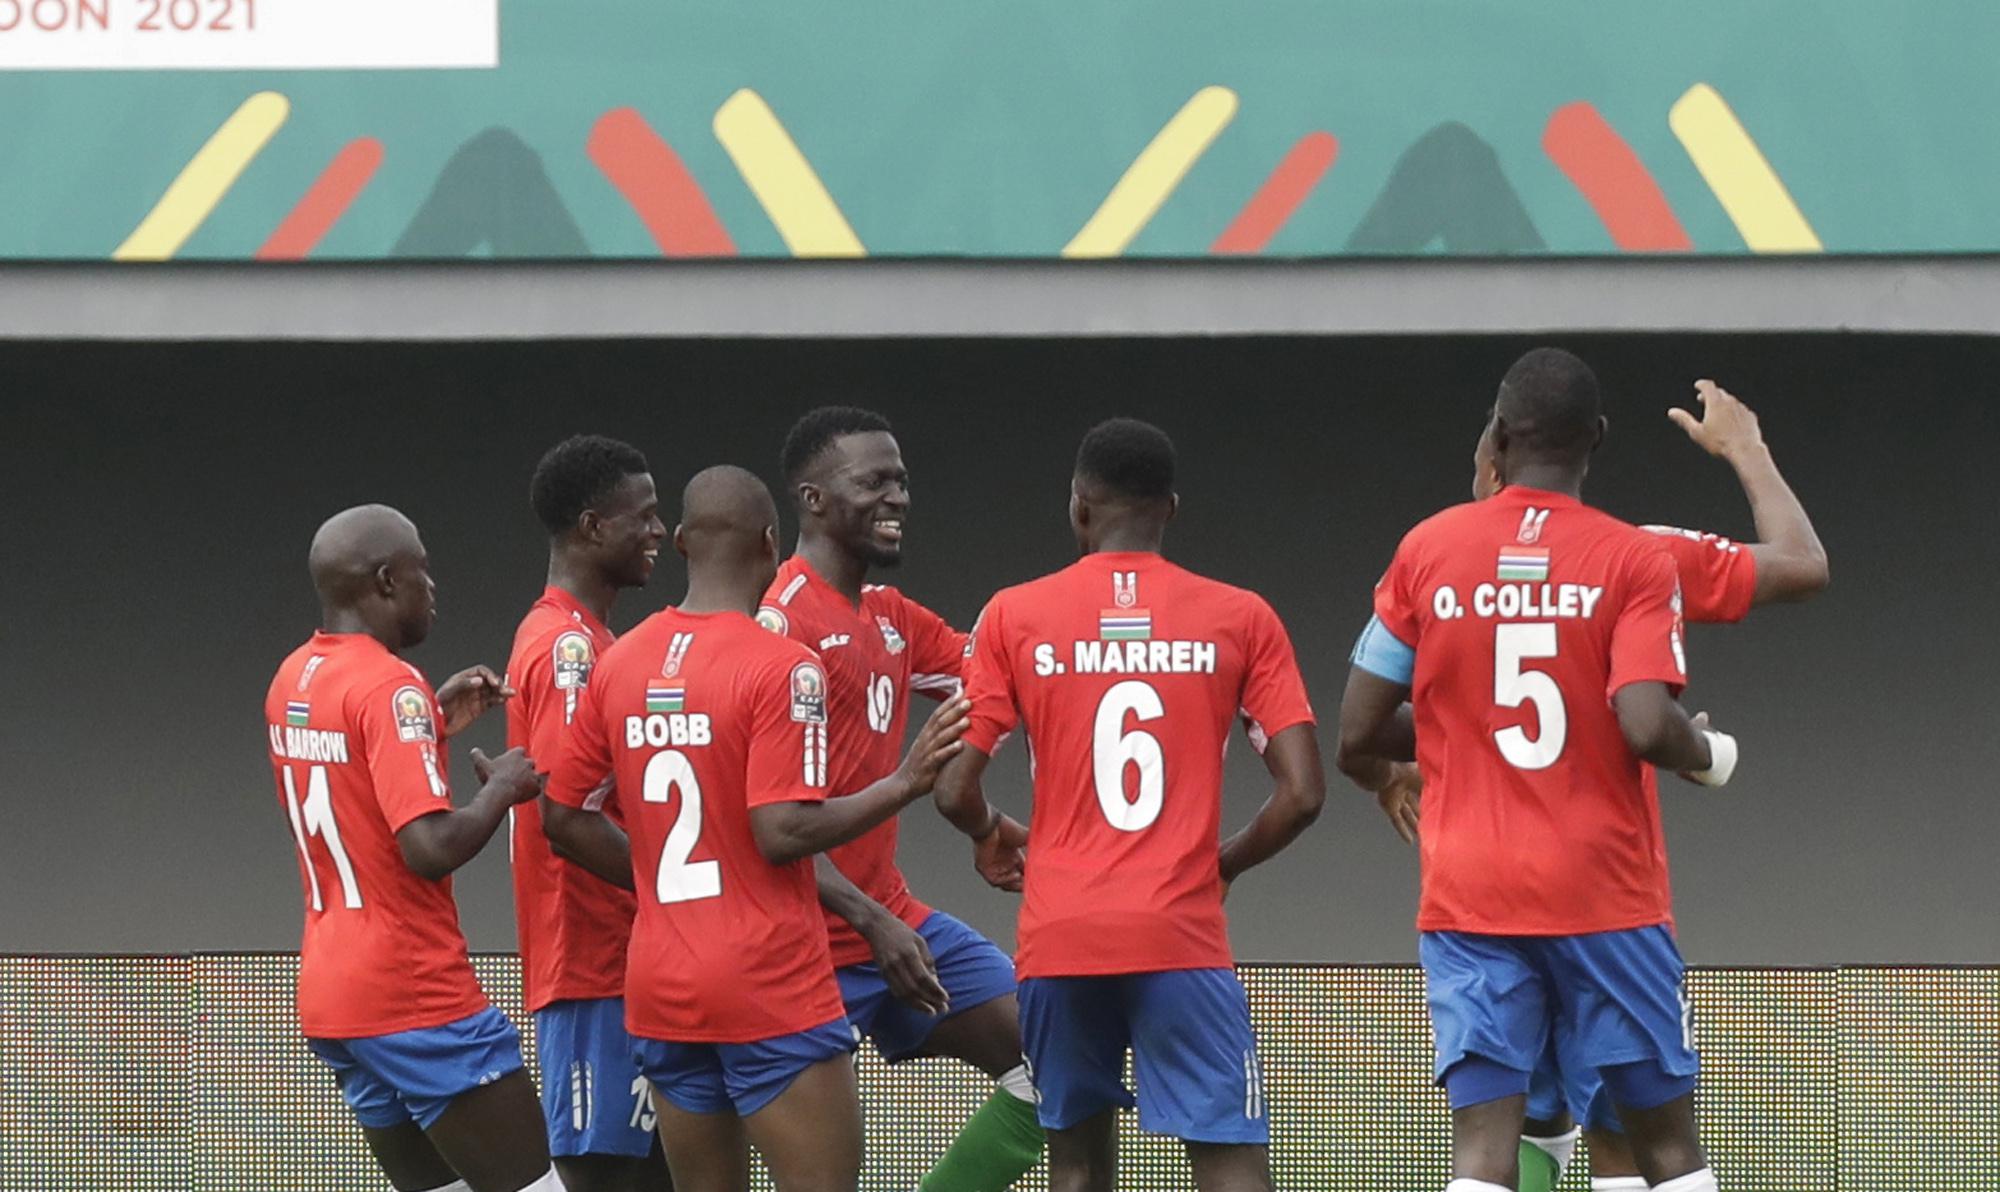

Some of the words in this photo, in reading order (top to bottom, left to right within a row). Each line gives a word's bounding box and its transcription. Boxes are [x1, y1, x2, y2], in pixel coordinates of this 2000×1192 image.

[136, 0, 256, 31] 2021
[1433, 585, 1464, 619] O.
[1473, 583, 1604, 619] COLLEY
[1033, 643, 1066, 676] S.
[1074, 641, 1217, 674] MARREH
[1493, 622, 1568, 771] 5
[285, 725, 349, 763] BARROW
[625, 713, 713, 748] BOBB
[1092, 680, 1165, 832] 6
[282, 764, 363, 912] 11
[643, 749, 722, 904] 2
